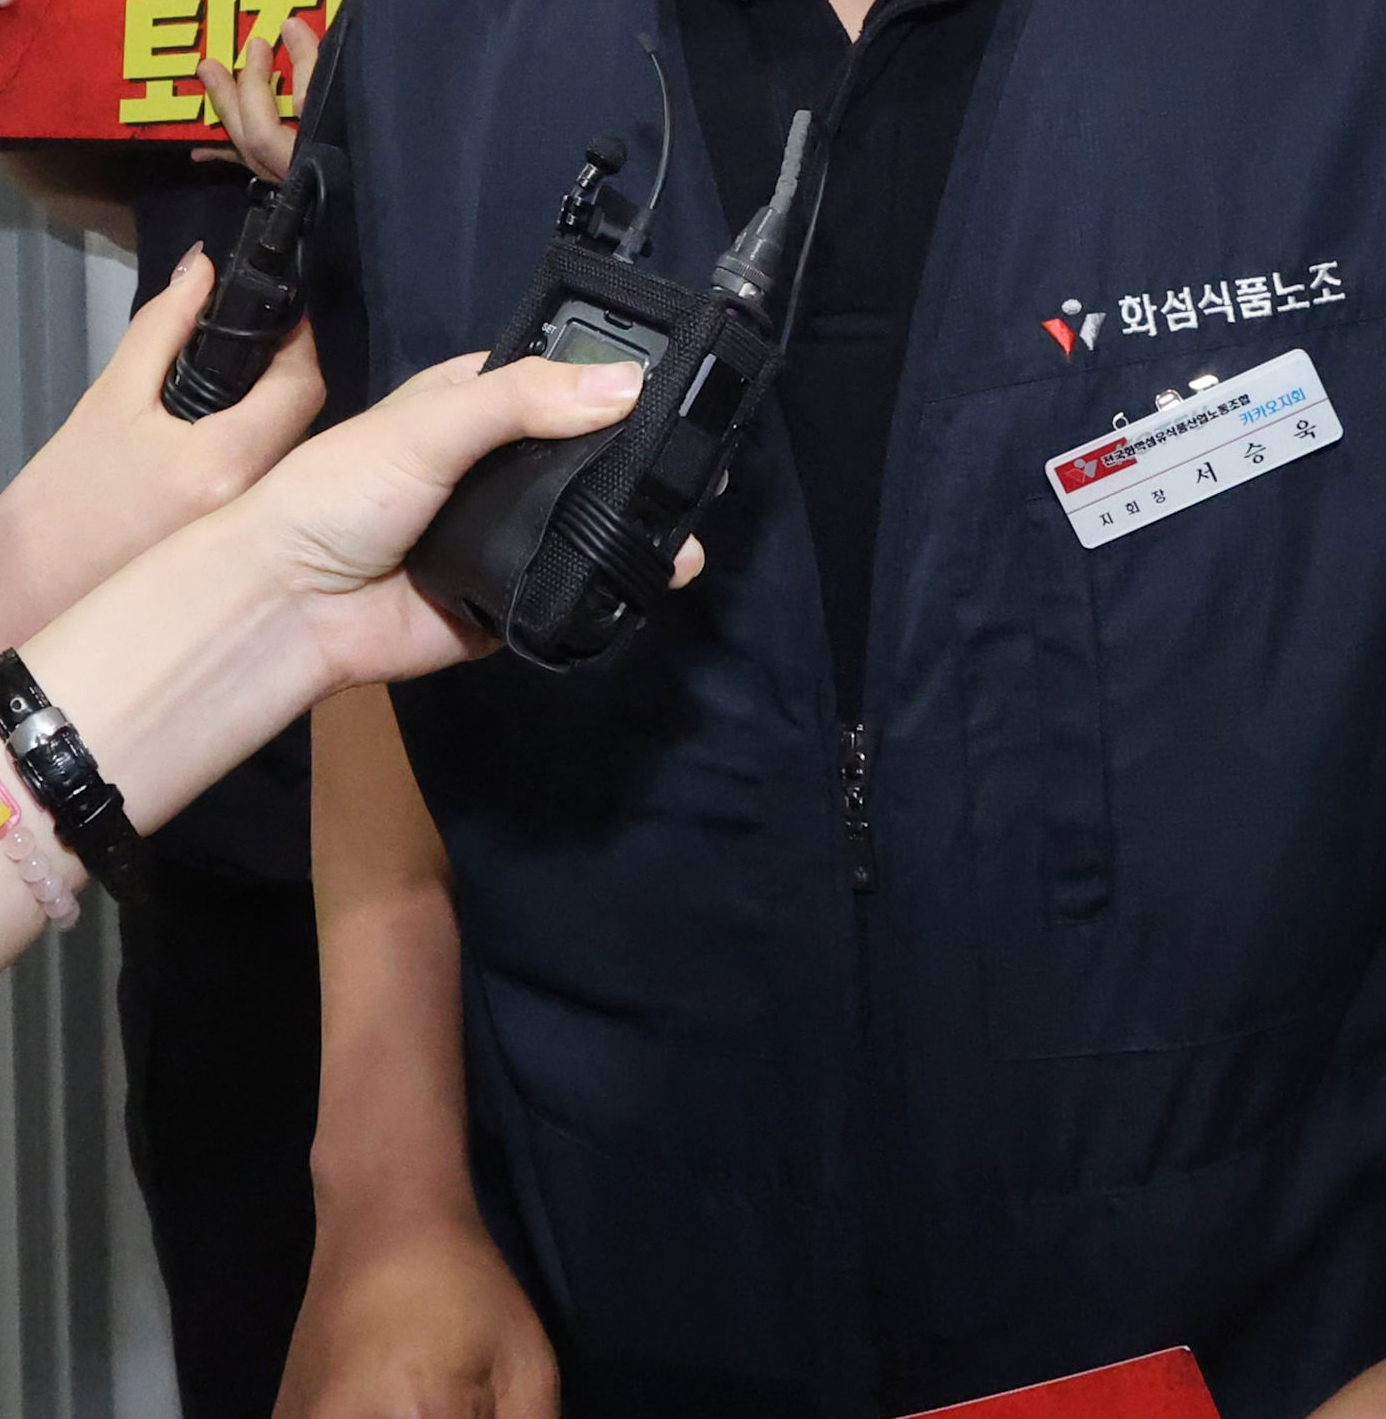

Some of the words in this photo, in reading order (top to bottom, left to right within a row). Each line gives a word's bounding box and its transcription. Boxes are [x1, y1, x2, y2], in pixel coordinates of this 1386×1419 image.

[1118, 260, 1347, 337] 화섬식품노조
[541, 322, 557, 334] SET
[1239, 387, 1307, 427] 카카오지회
